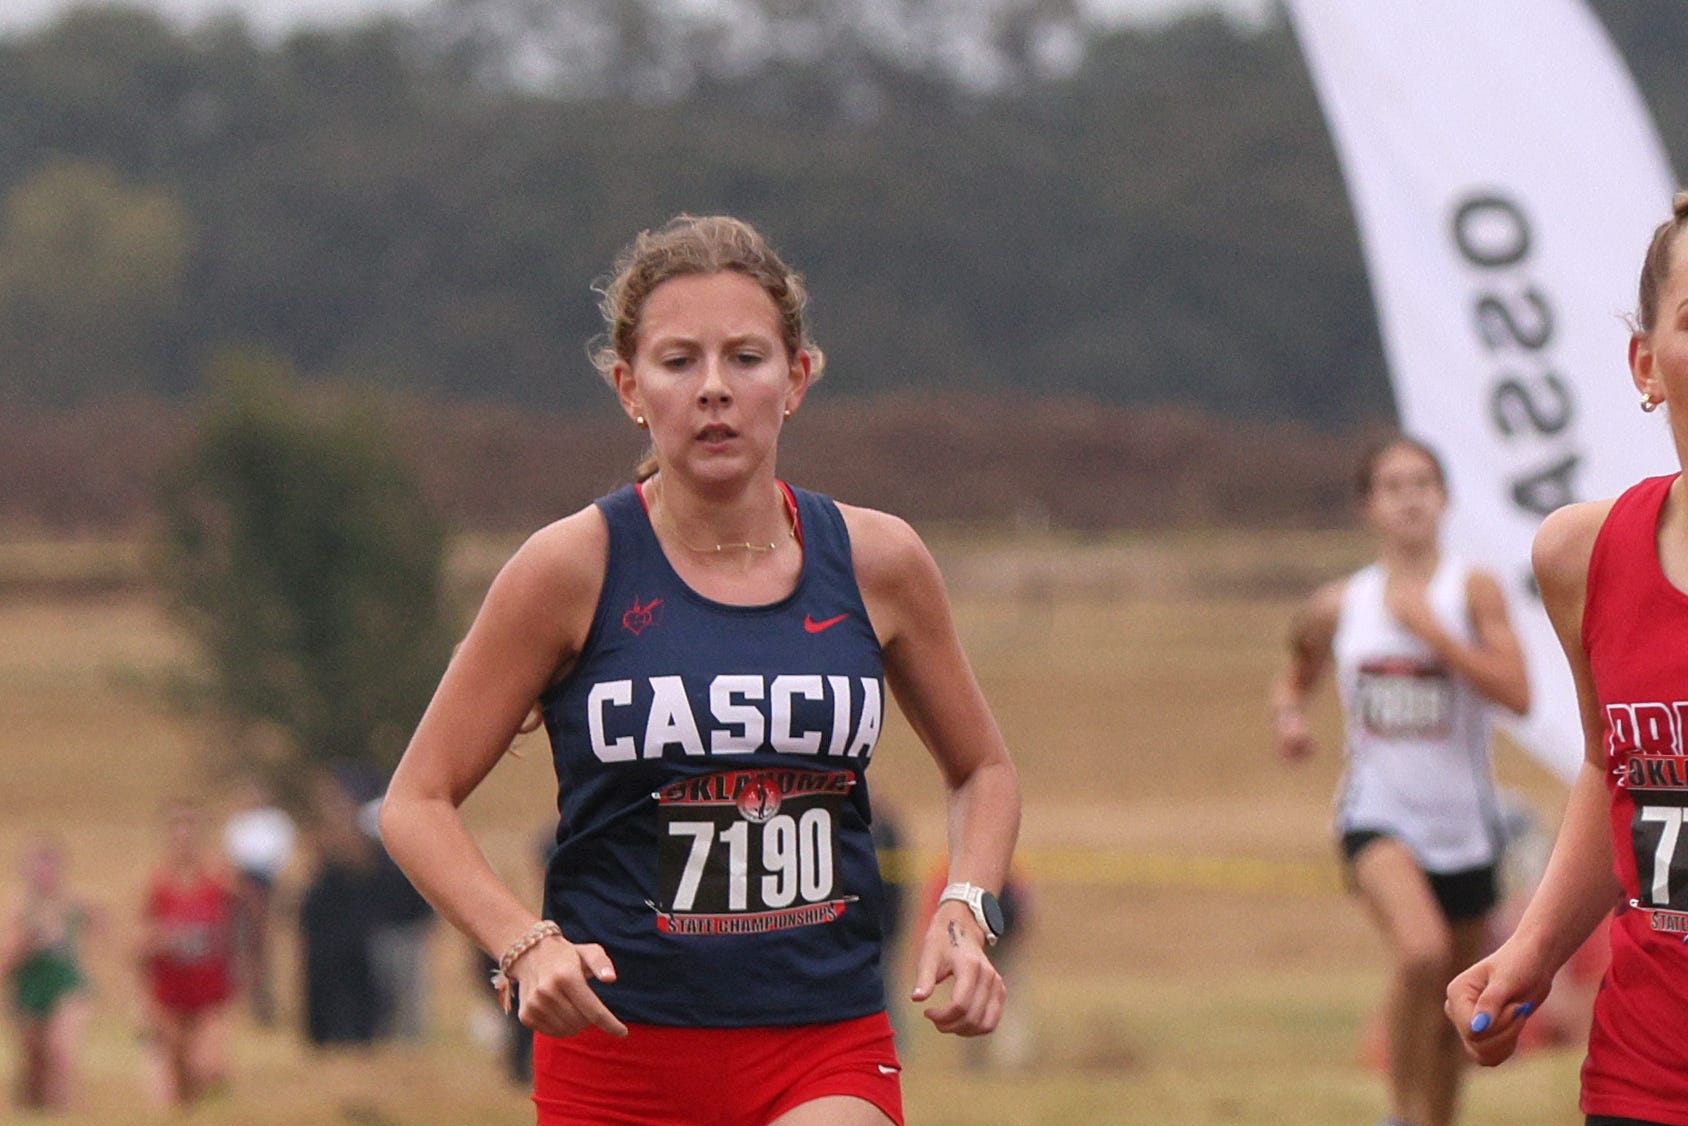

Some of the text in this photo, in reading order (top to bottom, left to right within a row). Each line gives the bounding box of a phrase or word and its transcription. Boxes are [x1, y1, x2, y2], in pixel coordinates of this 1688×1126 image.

[587, 674, 881, 762] CASCIA
[666, 769, 848, 801] OKLAOMA
[668, 808, 834, 911] 7190
[668, 905, 837, 933] STATE CHAMPIONSHIPS
[1651, 911, 1688, 932] STATE
